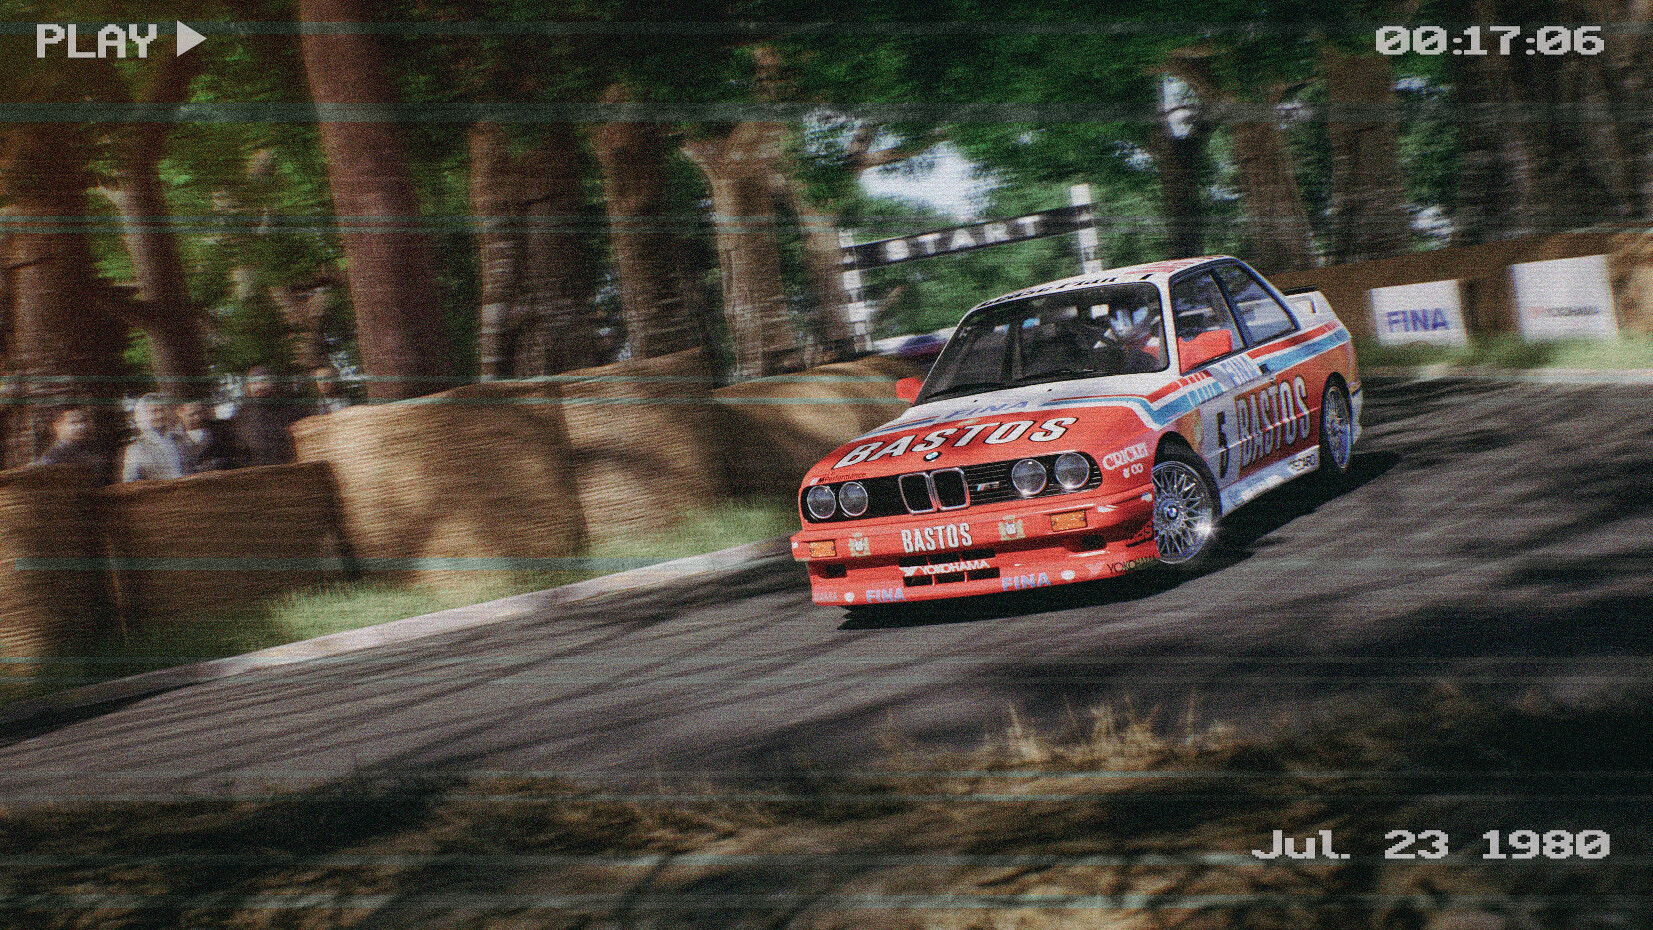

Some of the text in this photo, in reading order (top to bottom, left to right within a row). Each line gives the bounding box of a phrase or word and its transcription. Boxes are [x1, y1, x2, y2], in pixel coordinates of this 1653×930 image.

[886, 212, 1041, 262] START
[1386, 307, 1450, 334] FINA
[1236, 374, 1311, 468] BASTOS
[831, 415, 1080, 470] BASTOS
[901, 522, 973, 554] BASTOS
[919, 559, 990, 576] YOKOHAMA
[1001, 572, 1052, 592] FINA
[865, 587, 907, 603] FINA
